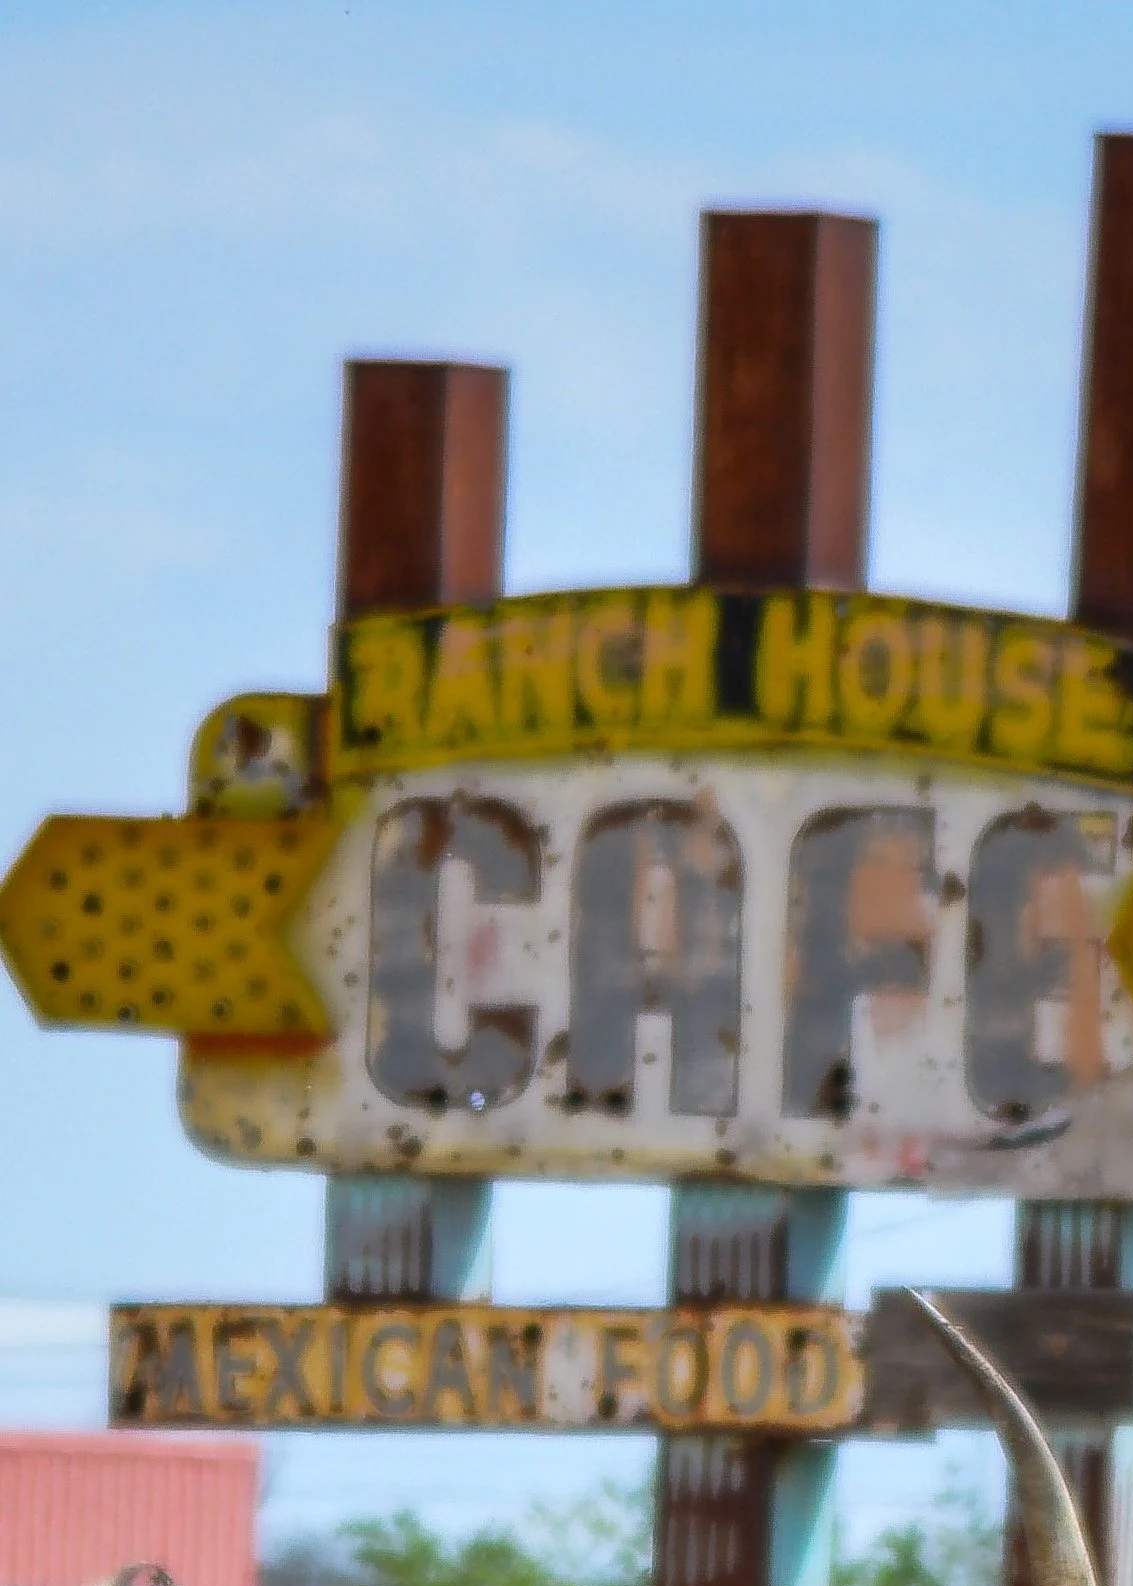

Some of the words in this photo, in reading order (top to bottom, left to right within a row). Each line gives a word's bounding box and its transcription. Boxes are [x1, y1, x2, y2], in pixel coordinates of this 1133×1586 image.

[347, 588, 717, 750] RANCH
[366, 797, 1117, 1146] CAFE
[114, 1316, 541, 1417] MEXICAN
[599, 1317, 842, 1418] FOOD
